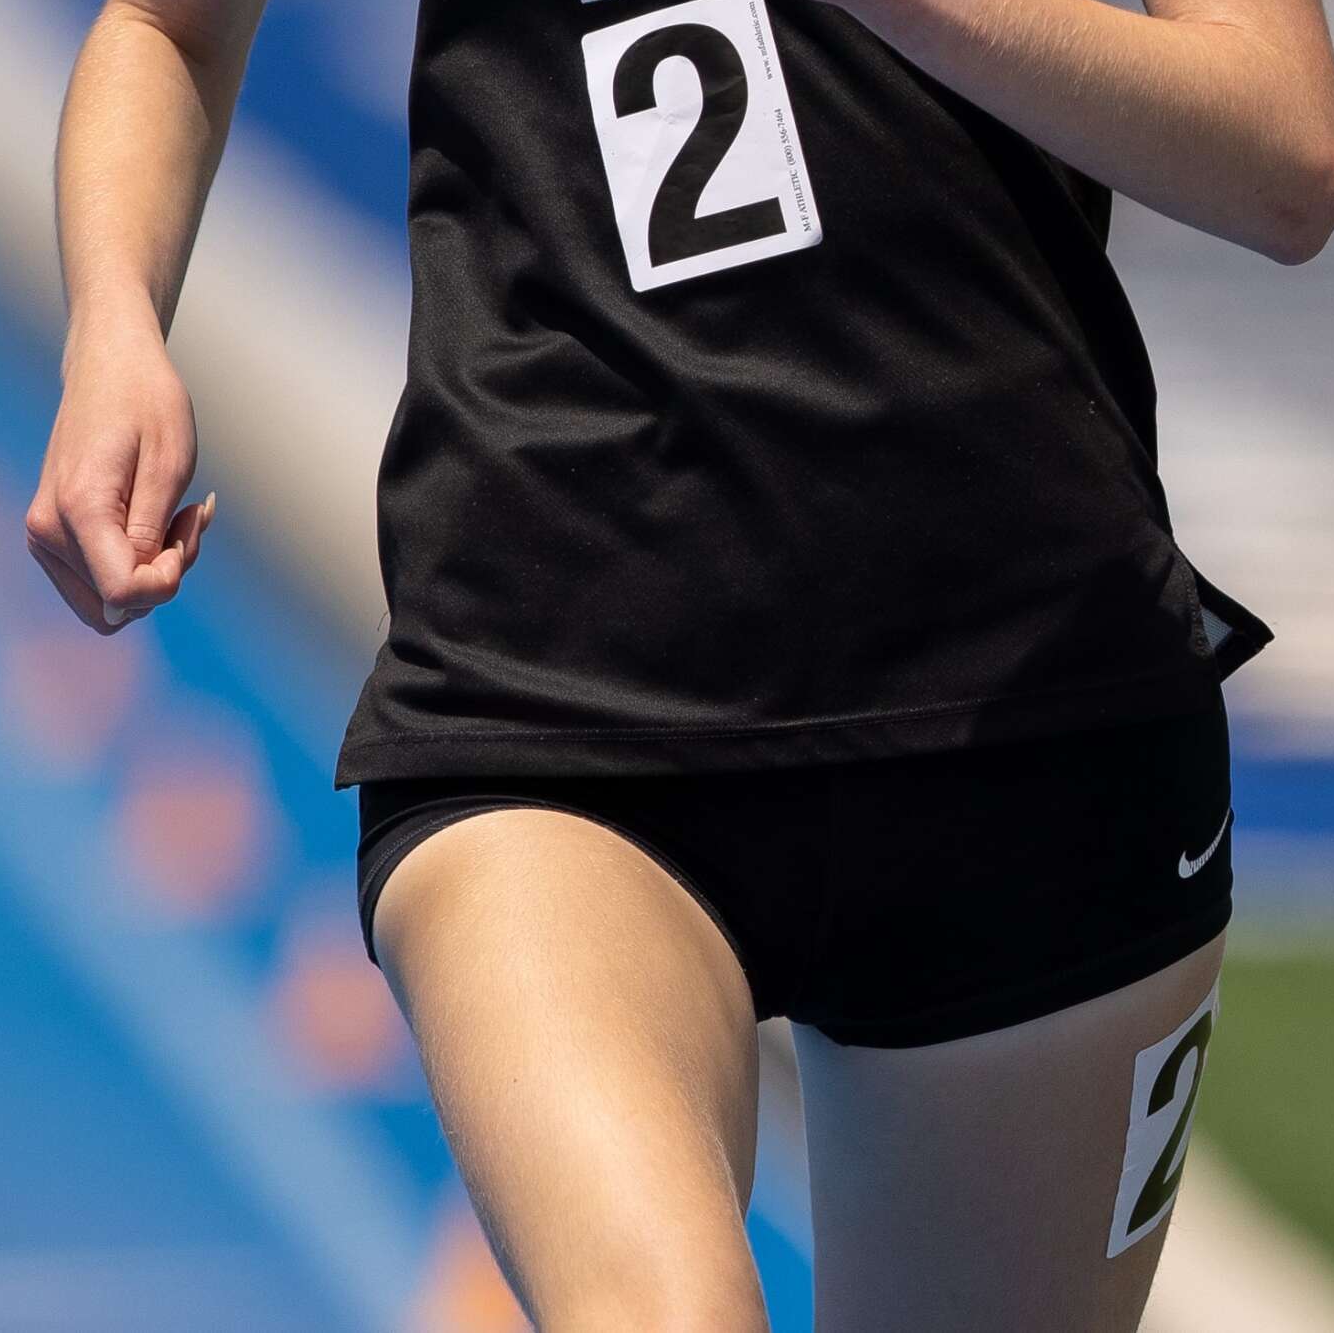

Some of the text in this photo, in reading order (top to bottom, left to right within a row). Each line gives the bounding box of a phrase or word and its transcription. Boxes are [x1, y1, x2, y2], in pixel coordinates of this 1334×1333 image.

[612, 22, 788, 269] 2
[789, 169, 808, 214] ATHLETIC
[1125, 1009, 1212, 1237] 2
